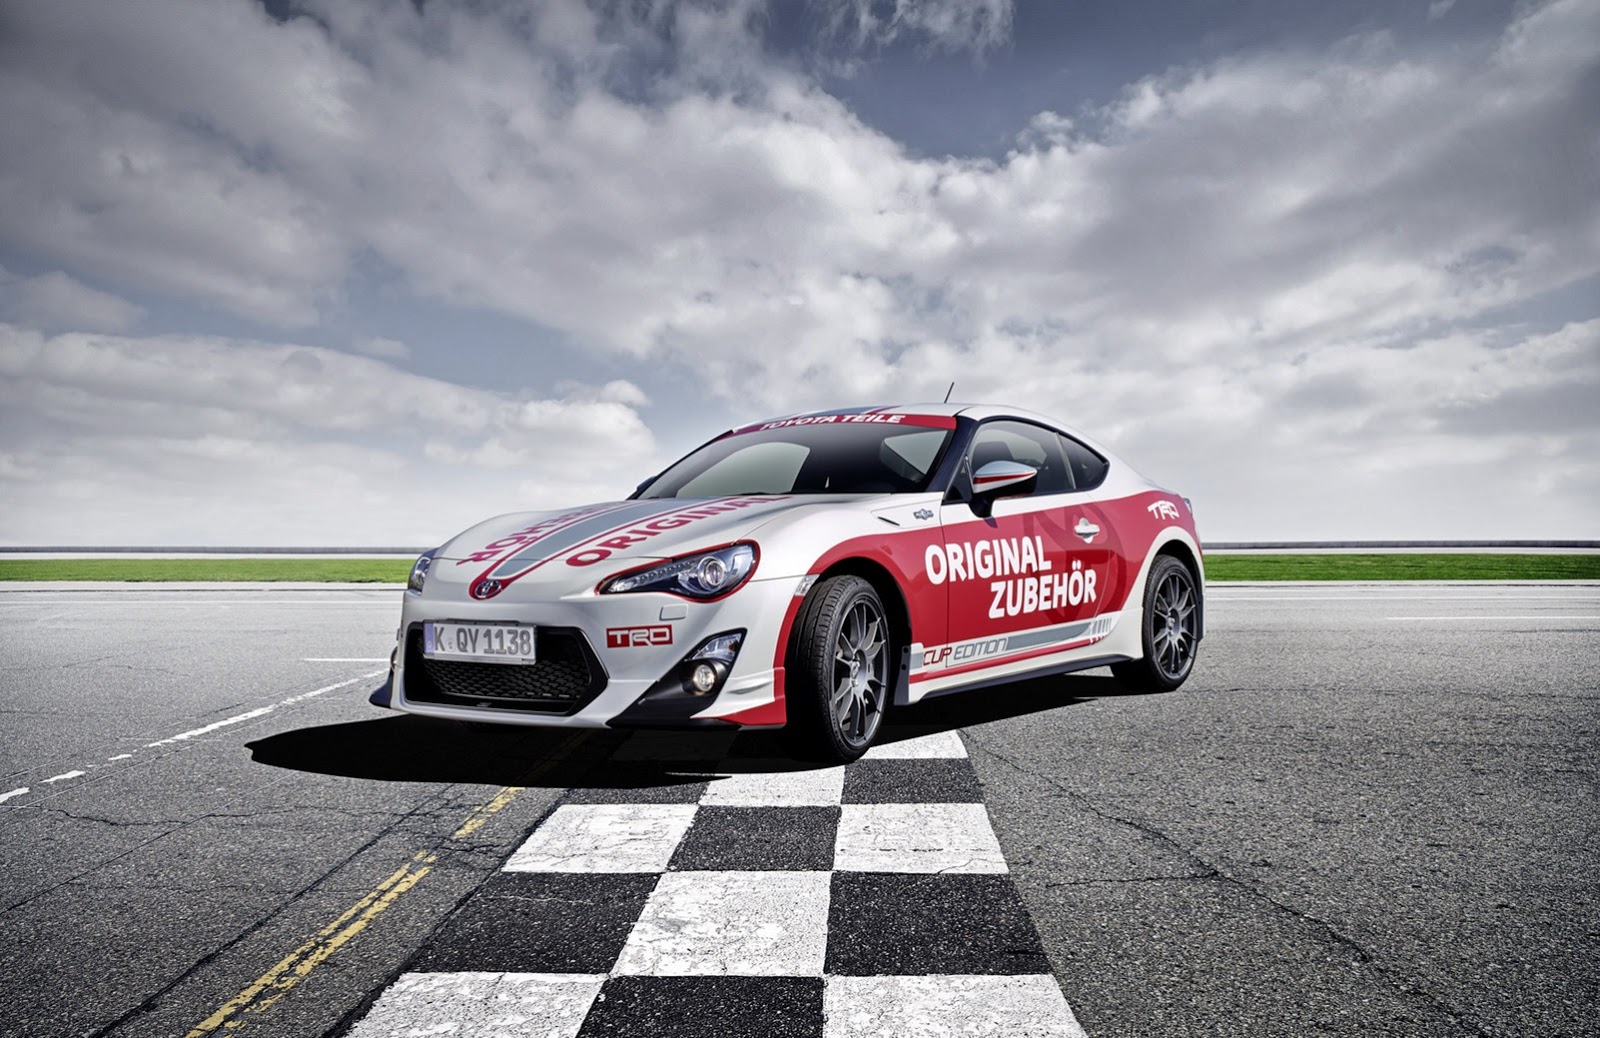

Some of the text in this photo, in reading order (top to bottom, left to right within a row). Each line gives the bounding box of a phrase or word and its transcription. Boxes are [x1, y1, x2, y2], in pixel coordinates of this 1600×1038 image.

[759, 413, 906, 431] TOYOTA TEILE
[1147, 500, 1180, 520] TRD
[456, 501, 612, 566] EHÖR
[565, 496, 793, 566] ORIGINAL
[924, 535, 1052, 585] ORIGINAL
[988, 559, 1098, 619] ZUBEHÖR
[434, 626, 533, 656] K QY 1138
[607, 627, 671, 648] TRD
[922, 637, 1008, 666] CUP EDITION
